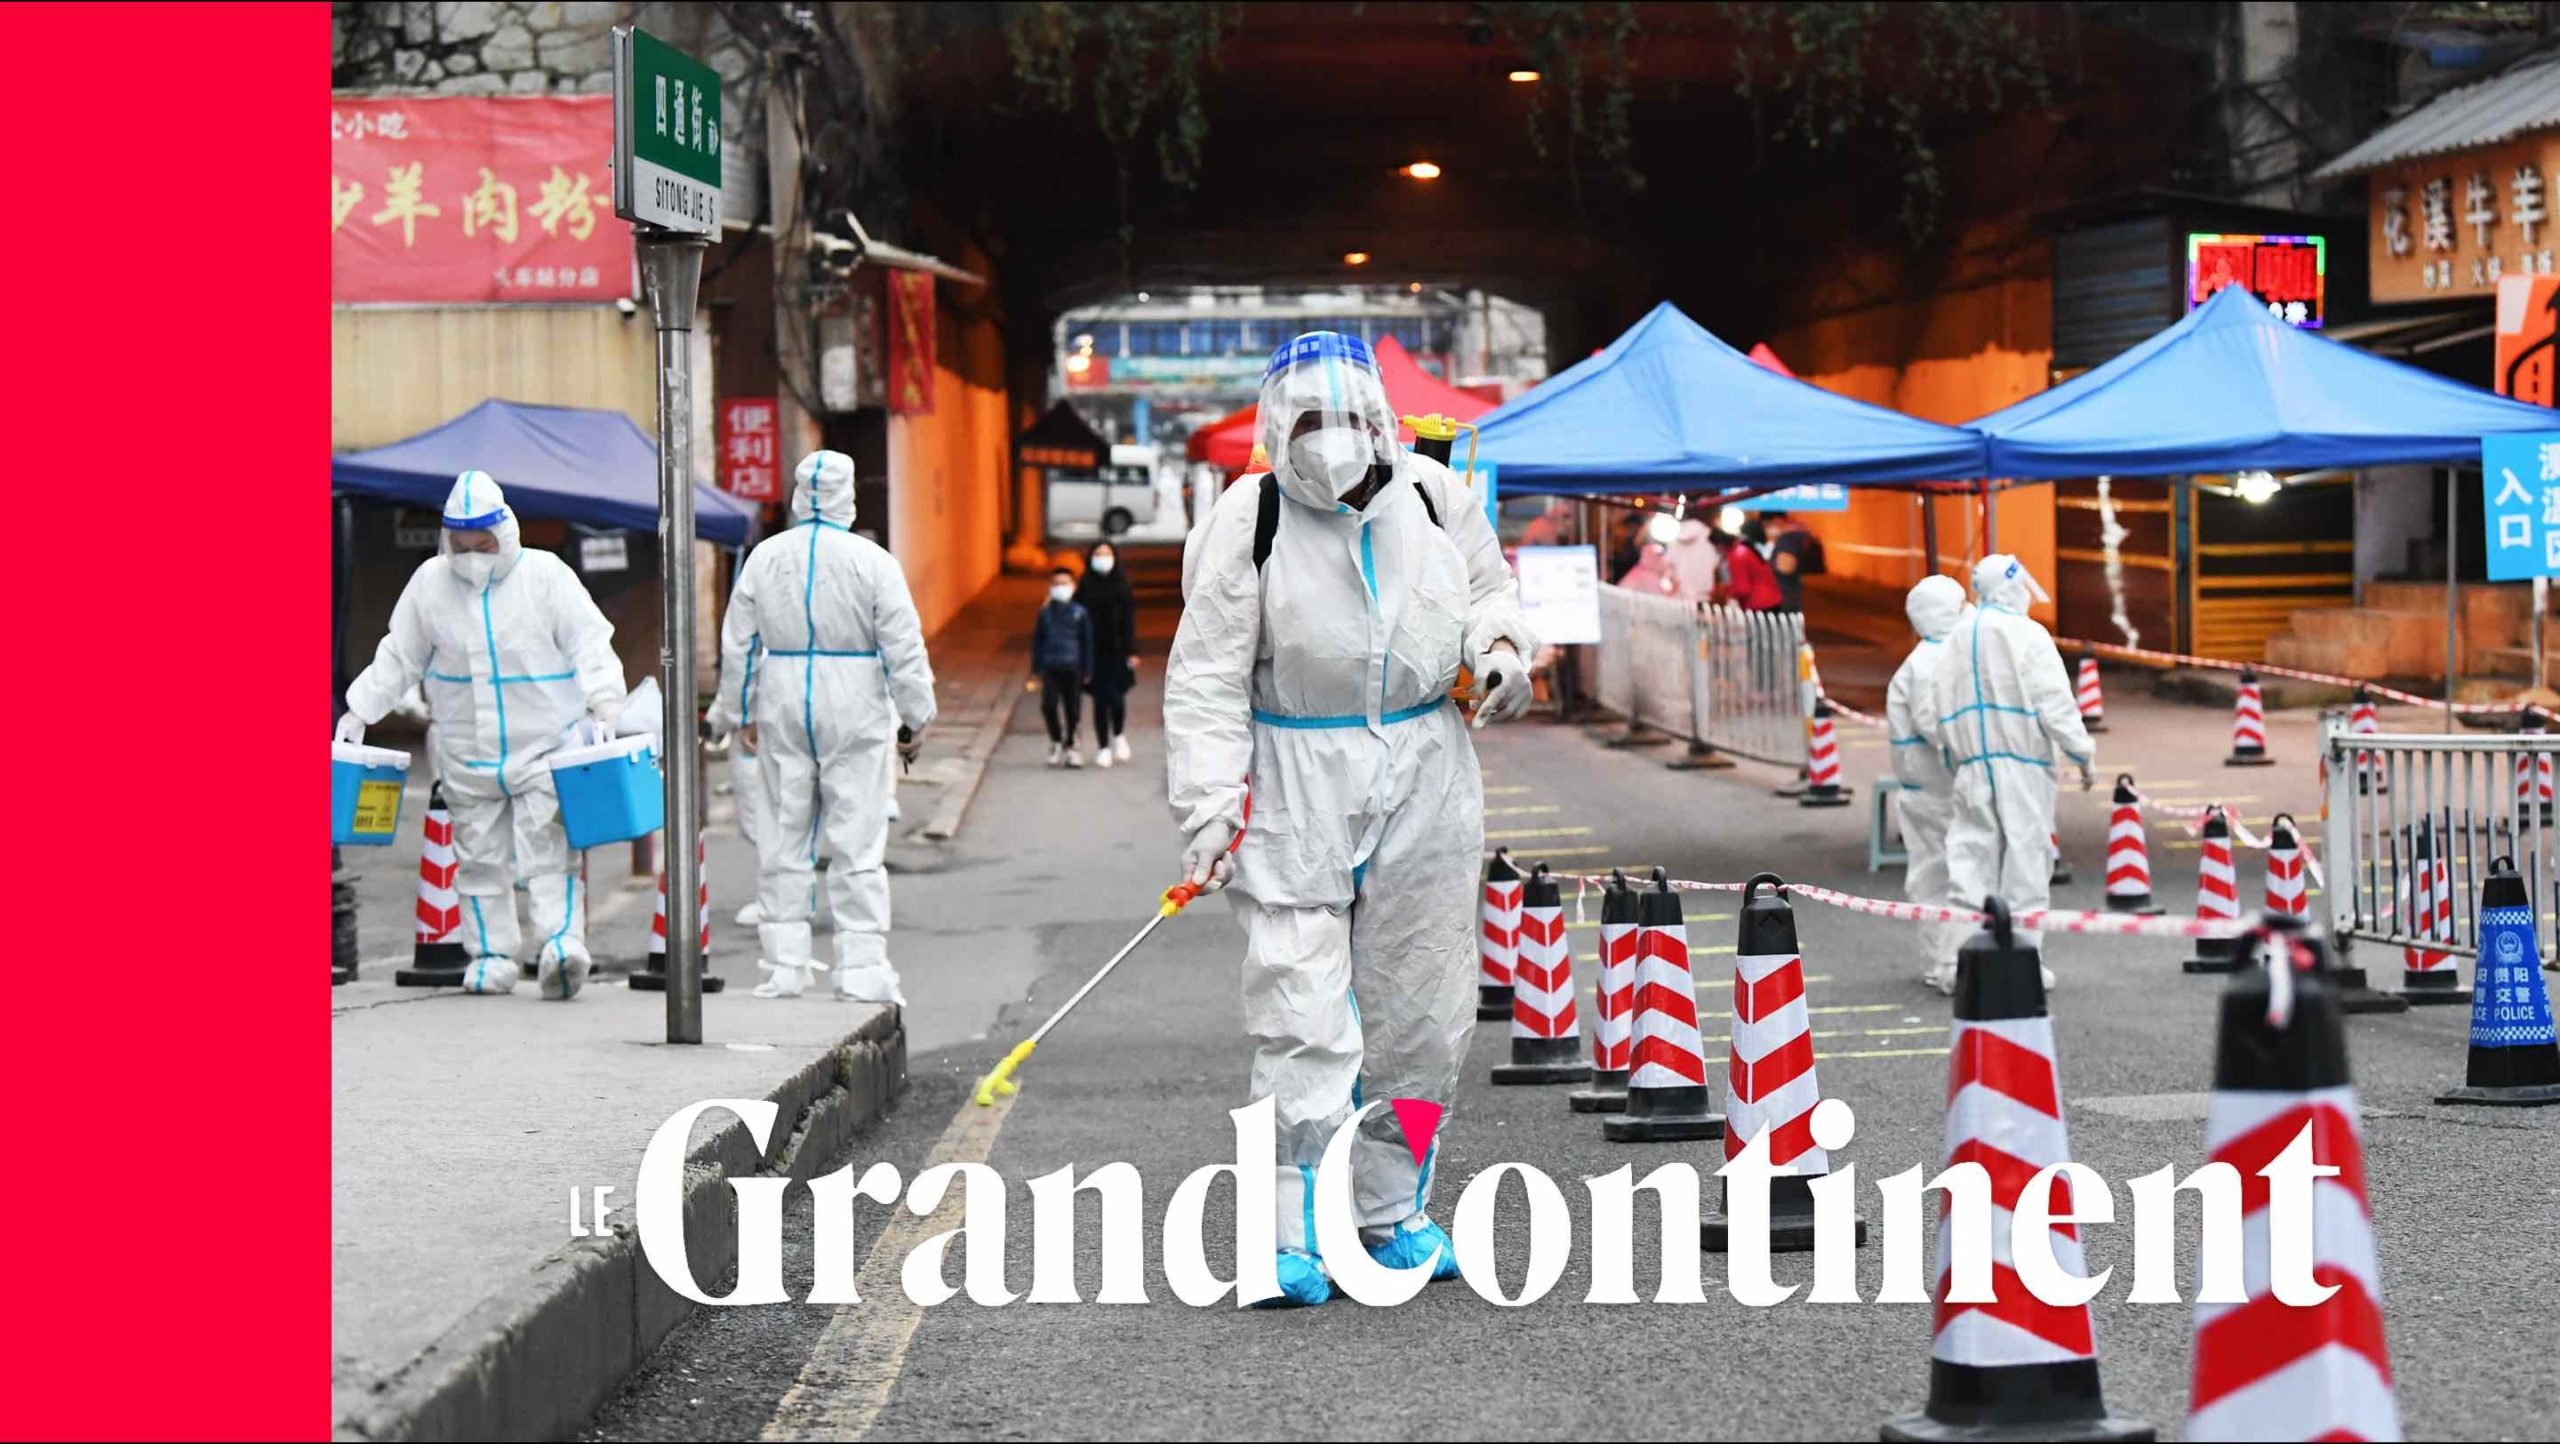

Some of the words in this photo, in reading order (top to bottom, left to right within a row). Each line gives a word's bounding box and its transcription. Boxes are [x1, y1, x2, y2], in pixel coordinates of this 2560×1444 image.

[655, 74, 703, 153] 四通街
[655, 177, 688, 217] SITONG
[691, 190, 704, 222] JIE
[708, 196, 714, 226] S
[2382, 166, 2560, 256] 花溪牛羊
[728, 405, 773, 496] 便利店
[2494, 467, 2534, 549] 入口
[2494, 967, 2529, 983] 贵阳
[2495, 986, 2531, 1004] 交警
[2494, 1005, 2535, 1021] POLICE
